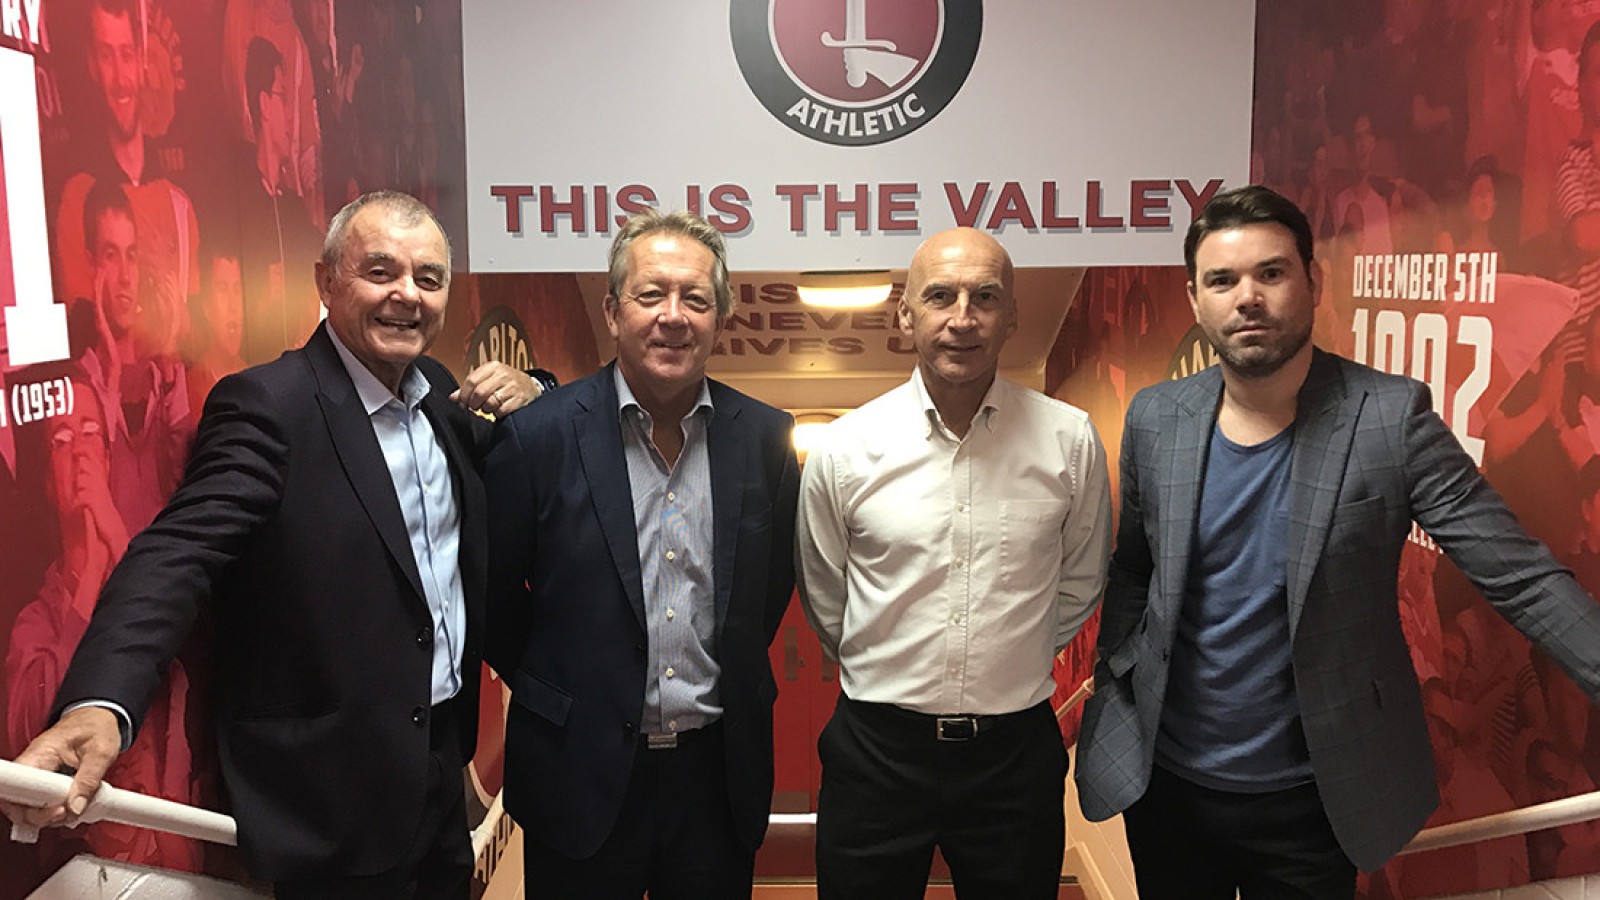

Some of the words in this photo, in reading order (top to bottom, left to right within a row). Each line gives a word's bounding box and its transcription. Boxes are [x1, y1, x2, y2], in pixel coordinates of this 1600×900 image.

[786, 92, 926, 137] ATHLETIC
[490, 184, 659, 237] THIS
[775, 183, 921, 236] THE
[943, 179, 1225, 233] VALLEY
[1352, 254, 1448, 300] DECEMBER
[1454, 252, 1498, 303] 5TH
[724, 312, 900, 331] NEVE
[711, 337, 865, 355] IVES
[12, 376, 74, 426] (1953)
